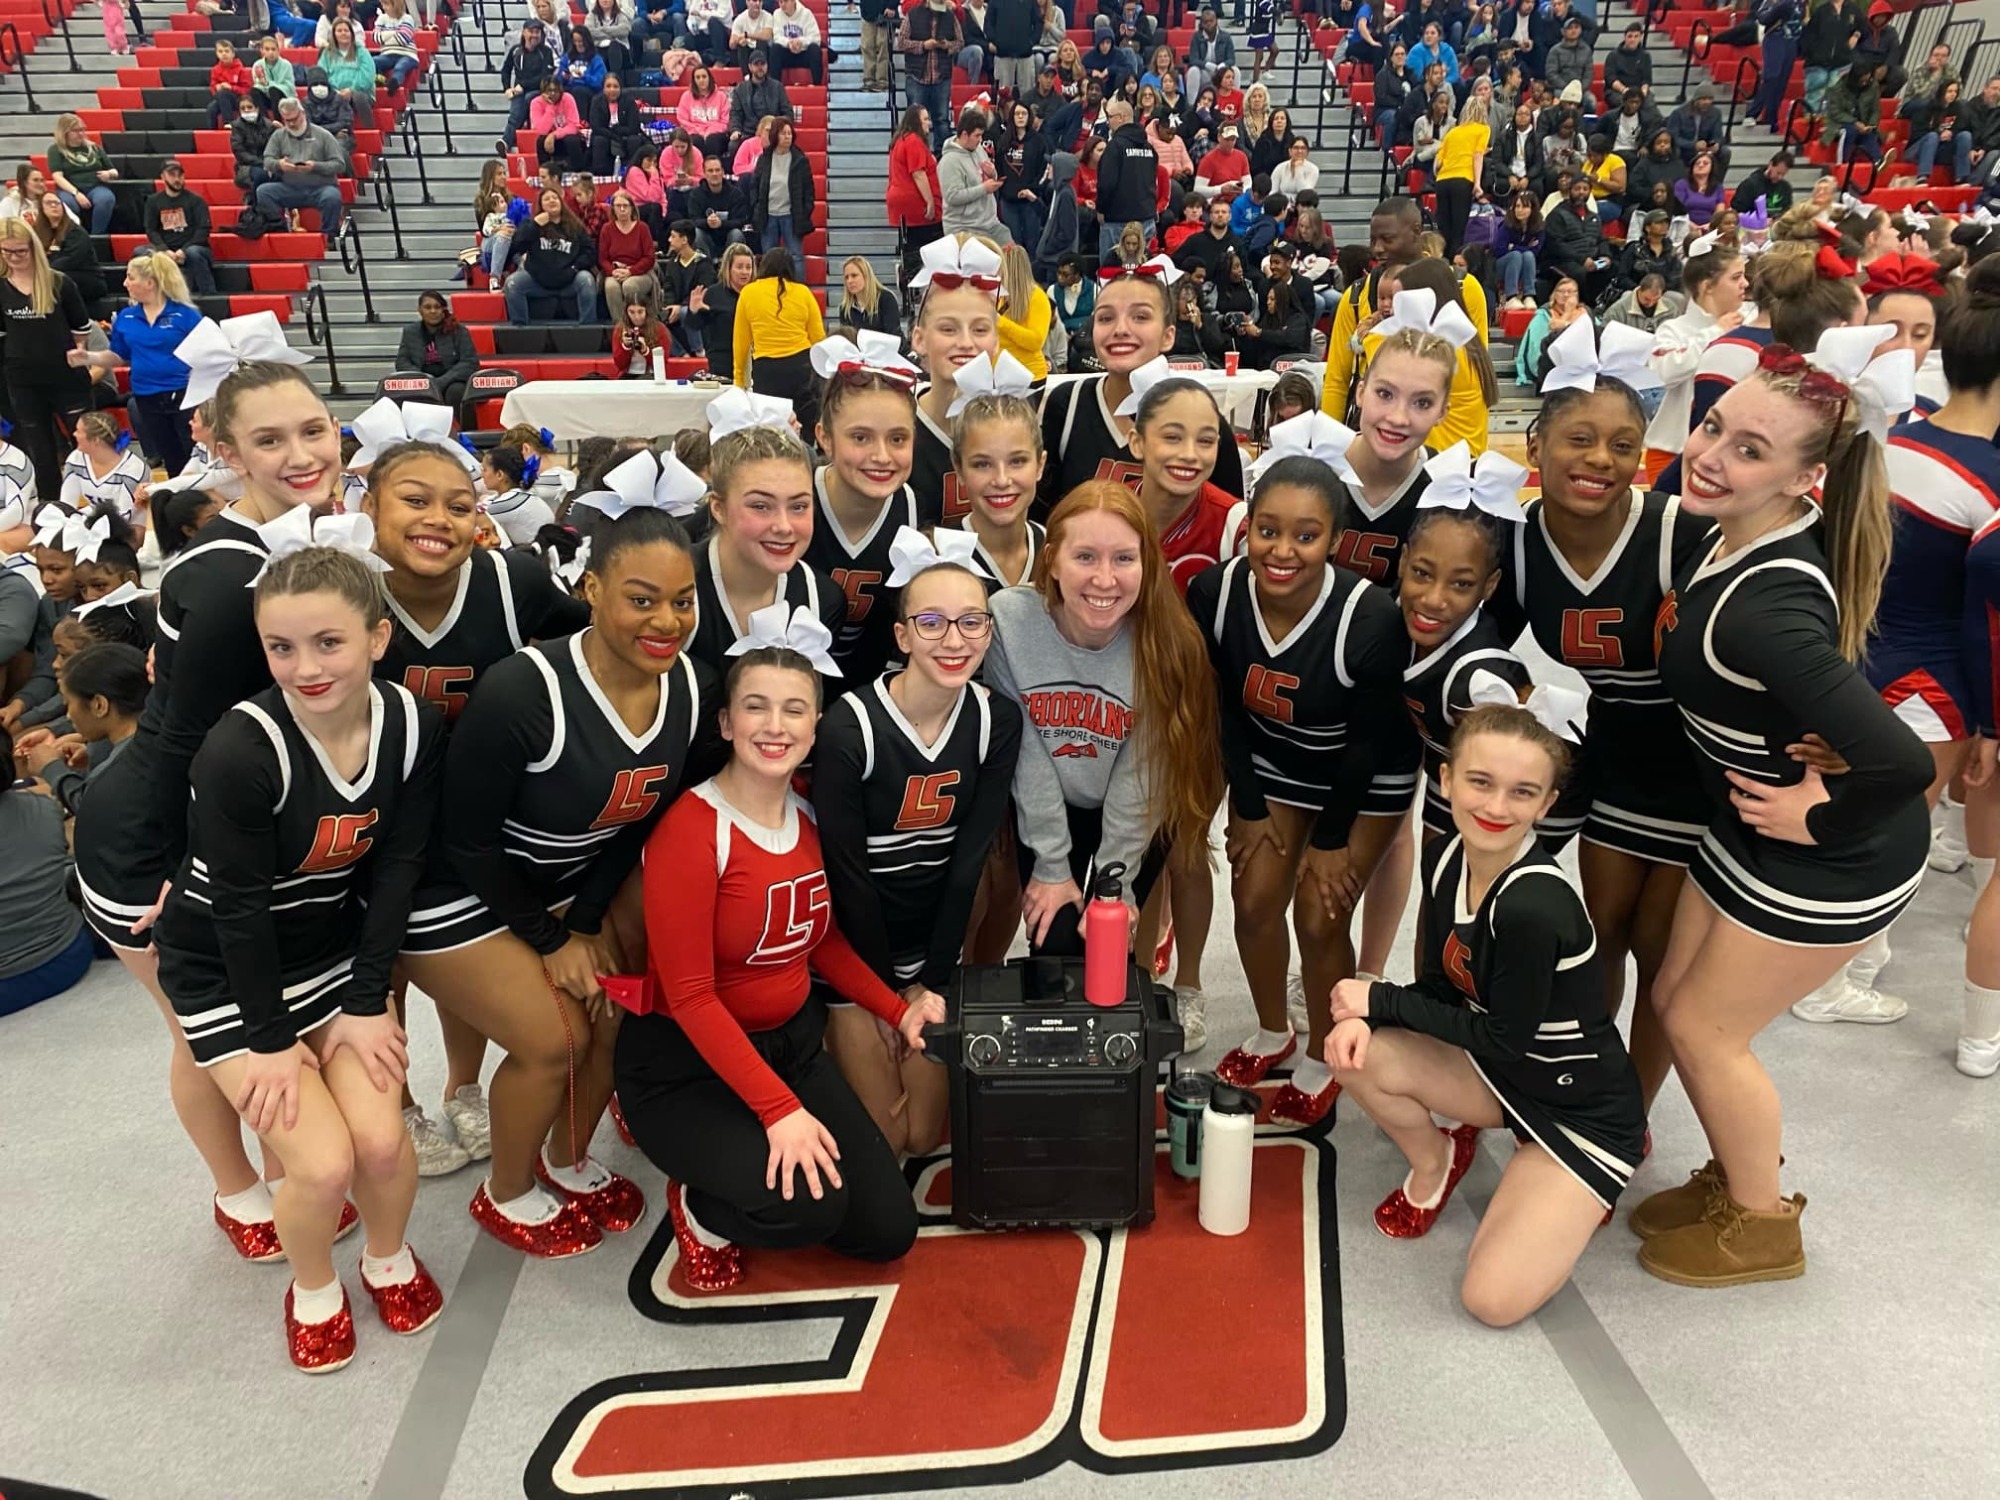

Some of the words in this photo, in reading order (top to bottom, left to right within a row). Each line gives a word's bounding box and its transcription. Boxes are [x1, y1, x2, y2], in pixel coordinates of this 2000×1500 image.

[384, 379, 430, 390] SHORIANS
[473, 376, 518, 388] SHORIANS
[1561, 608, 1624, 667] LS
[1243, 663, 1300, 723] LS
[1089, 735, 1119, 751] CHEE
[589, 764, 668, 829] LS
[893, 769, 961, 831] LS
[294, 808, 379, 873] LS
[745, 869, 830, 965] LS
